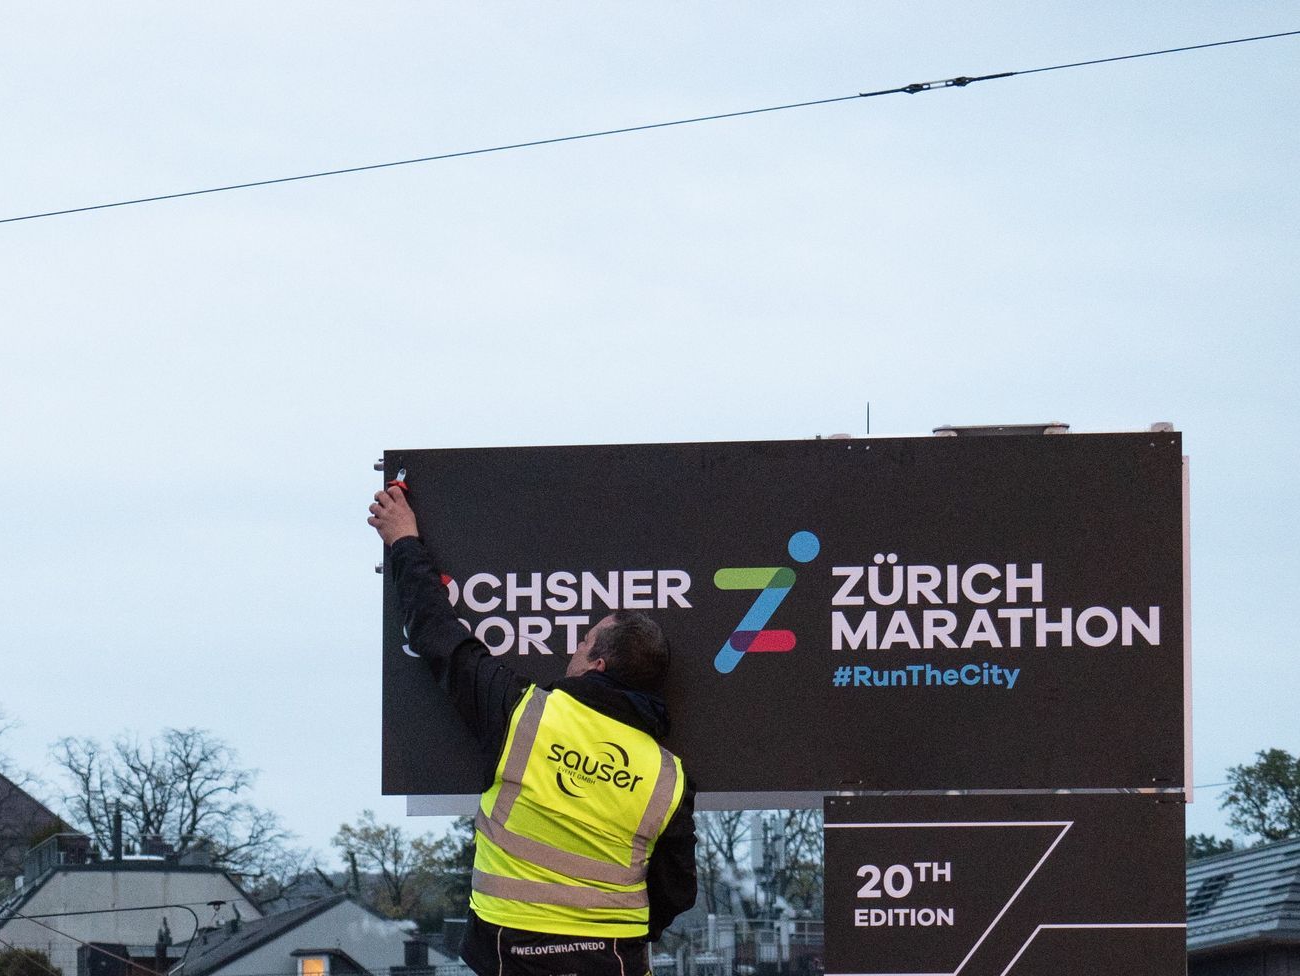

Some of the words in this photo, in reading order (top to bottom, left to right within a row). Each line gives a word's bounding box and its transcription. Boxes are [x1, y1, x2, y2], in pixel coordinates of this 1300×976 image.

[832, 553, 1043, 606] ZÜRICH
[402, 614, 589, 657] ORT
[832, 606, 1162, 651] MARATHON
[832, 663, 1020, 690] #RunTheCity
[547, 743, 643, 792] sauser
[854, 908, 954, 927] EDITION
[510, 941, 605, 956] #WELOVEWHATWEDO
